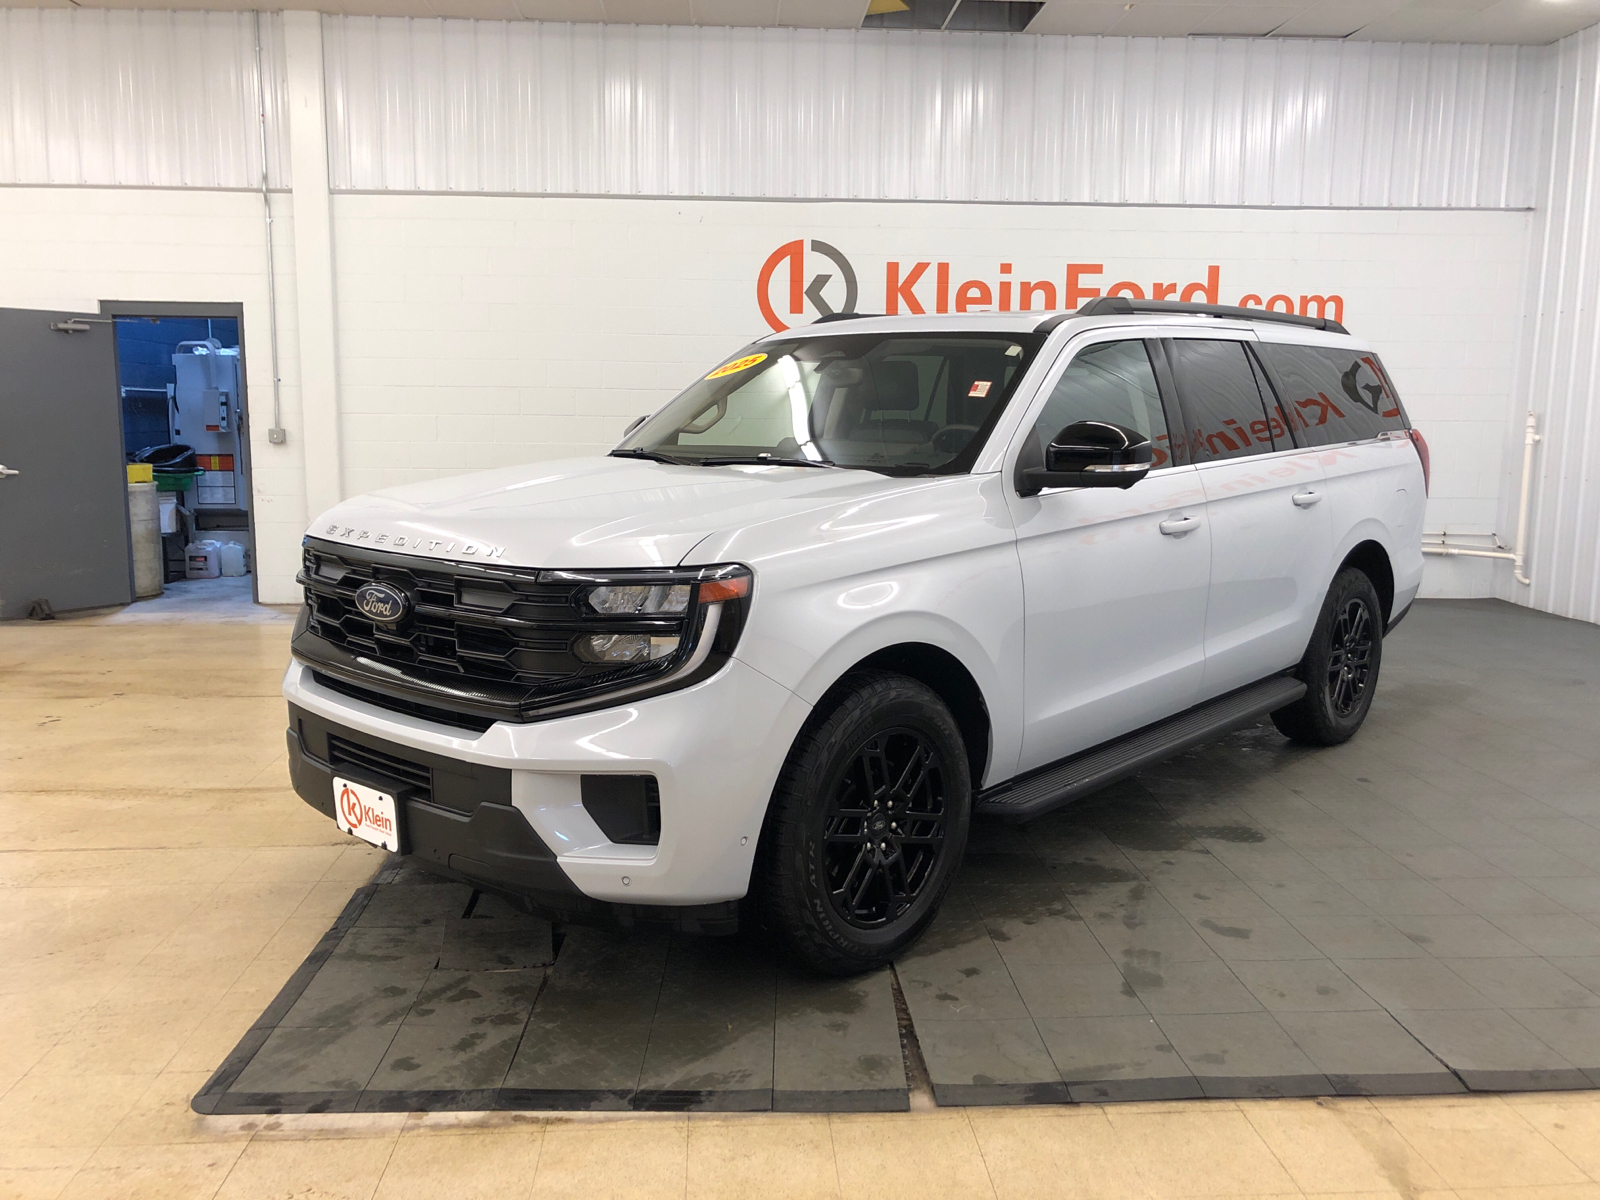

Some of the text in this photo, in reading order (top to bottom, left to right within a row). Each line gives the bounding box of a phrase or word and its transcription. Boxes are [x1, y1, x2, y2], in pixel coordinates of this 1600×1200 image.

[886, 262, 1343, 323] KleinFordcom
[326, 524, 507, 558] EXPEDITION
[363, 590, 392, 616] Ford
[363, 804, 392, 832] Klein
